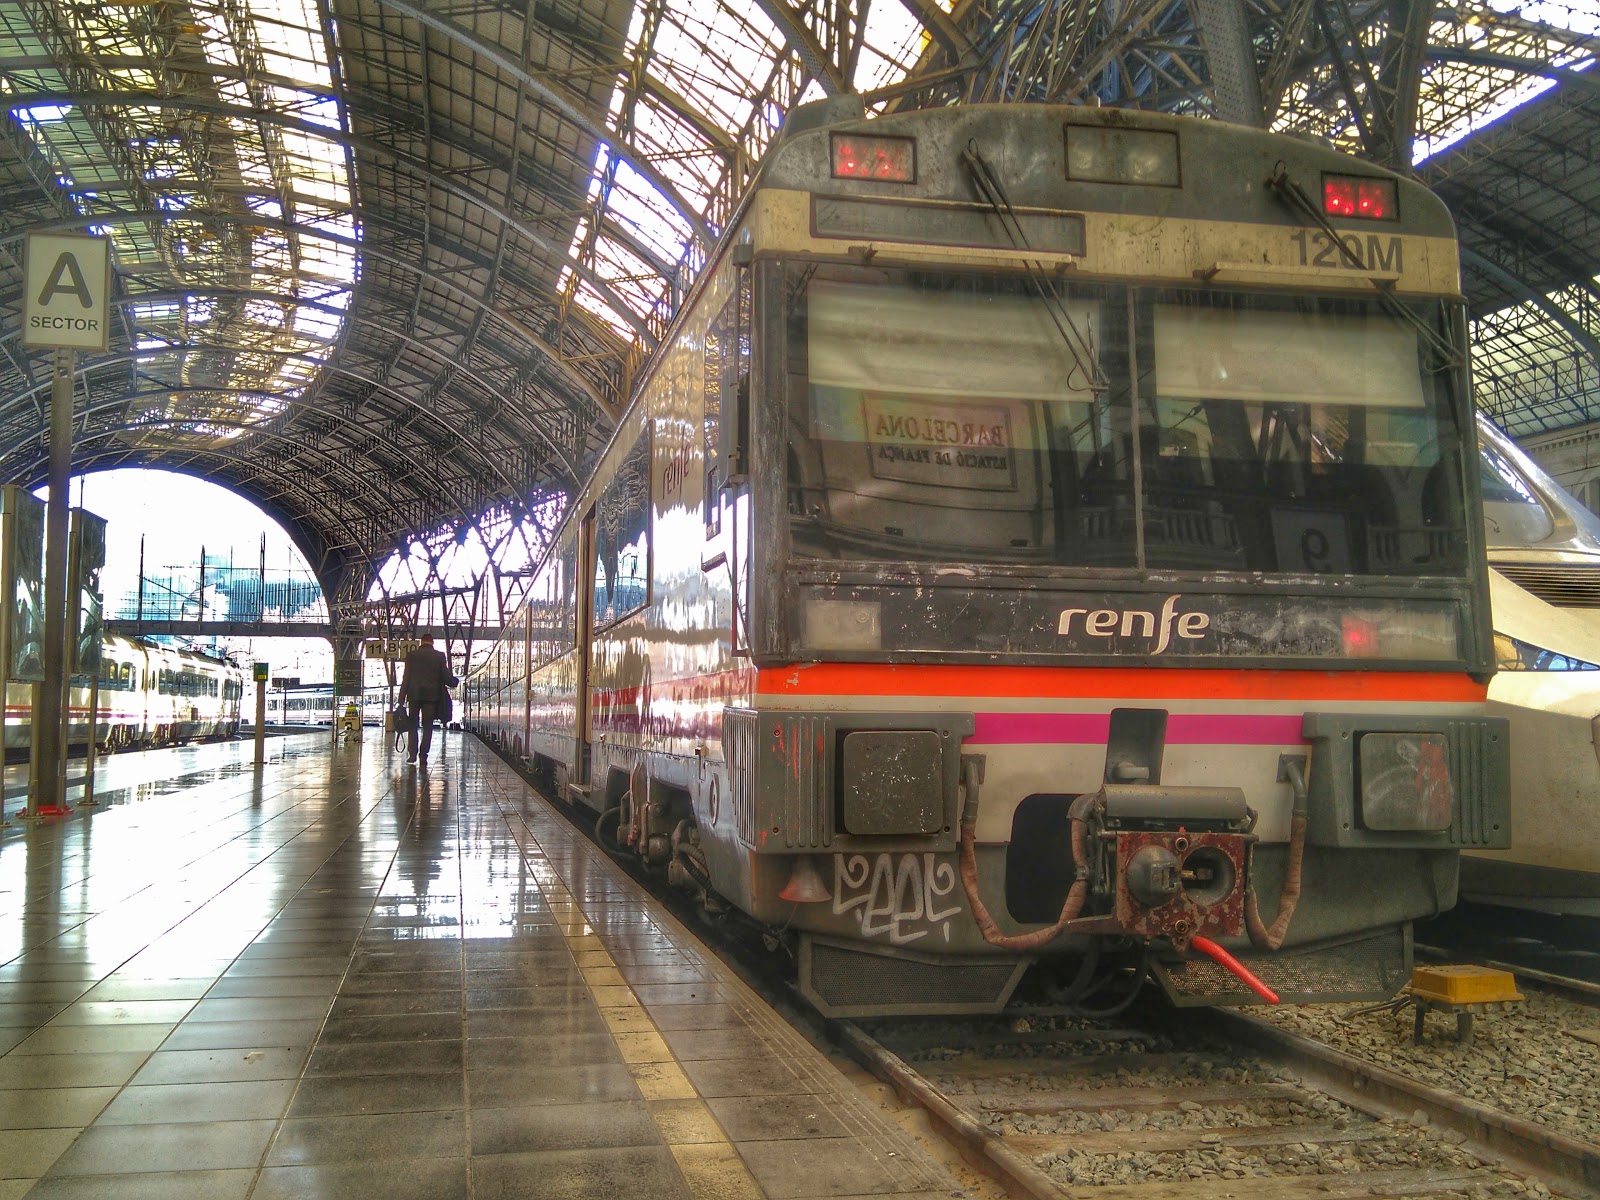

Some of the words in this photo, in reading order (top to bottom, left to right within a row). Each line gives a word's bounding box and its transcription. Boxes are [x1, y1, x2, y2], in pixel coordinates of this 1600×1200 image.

[1291, 231, 1403, 273] 120M
[38, 252, 93, 309] A
[30, 316, 98, 331] SECTOR
[662, 424, 691, 500] renfe
[1058, 594, 1210, 656] renfe
[369, 644, 382, 655] 11
[388, 642, 397, 653] B
